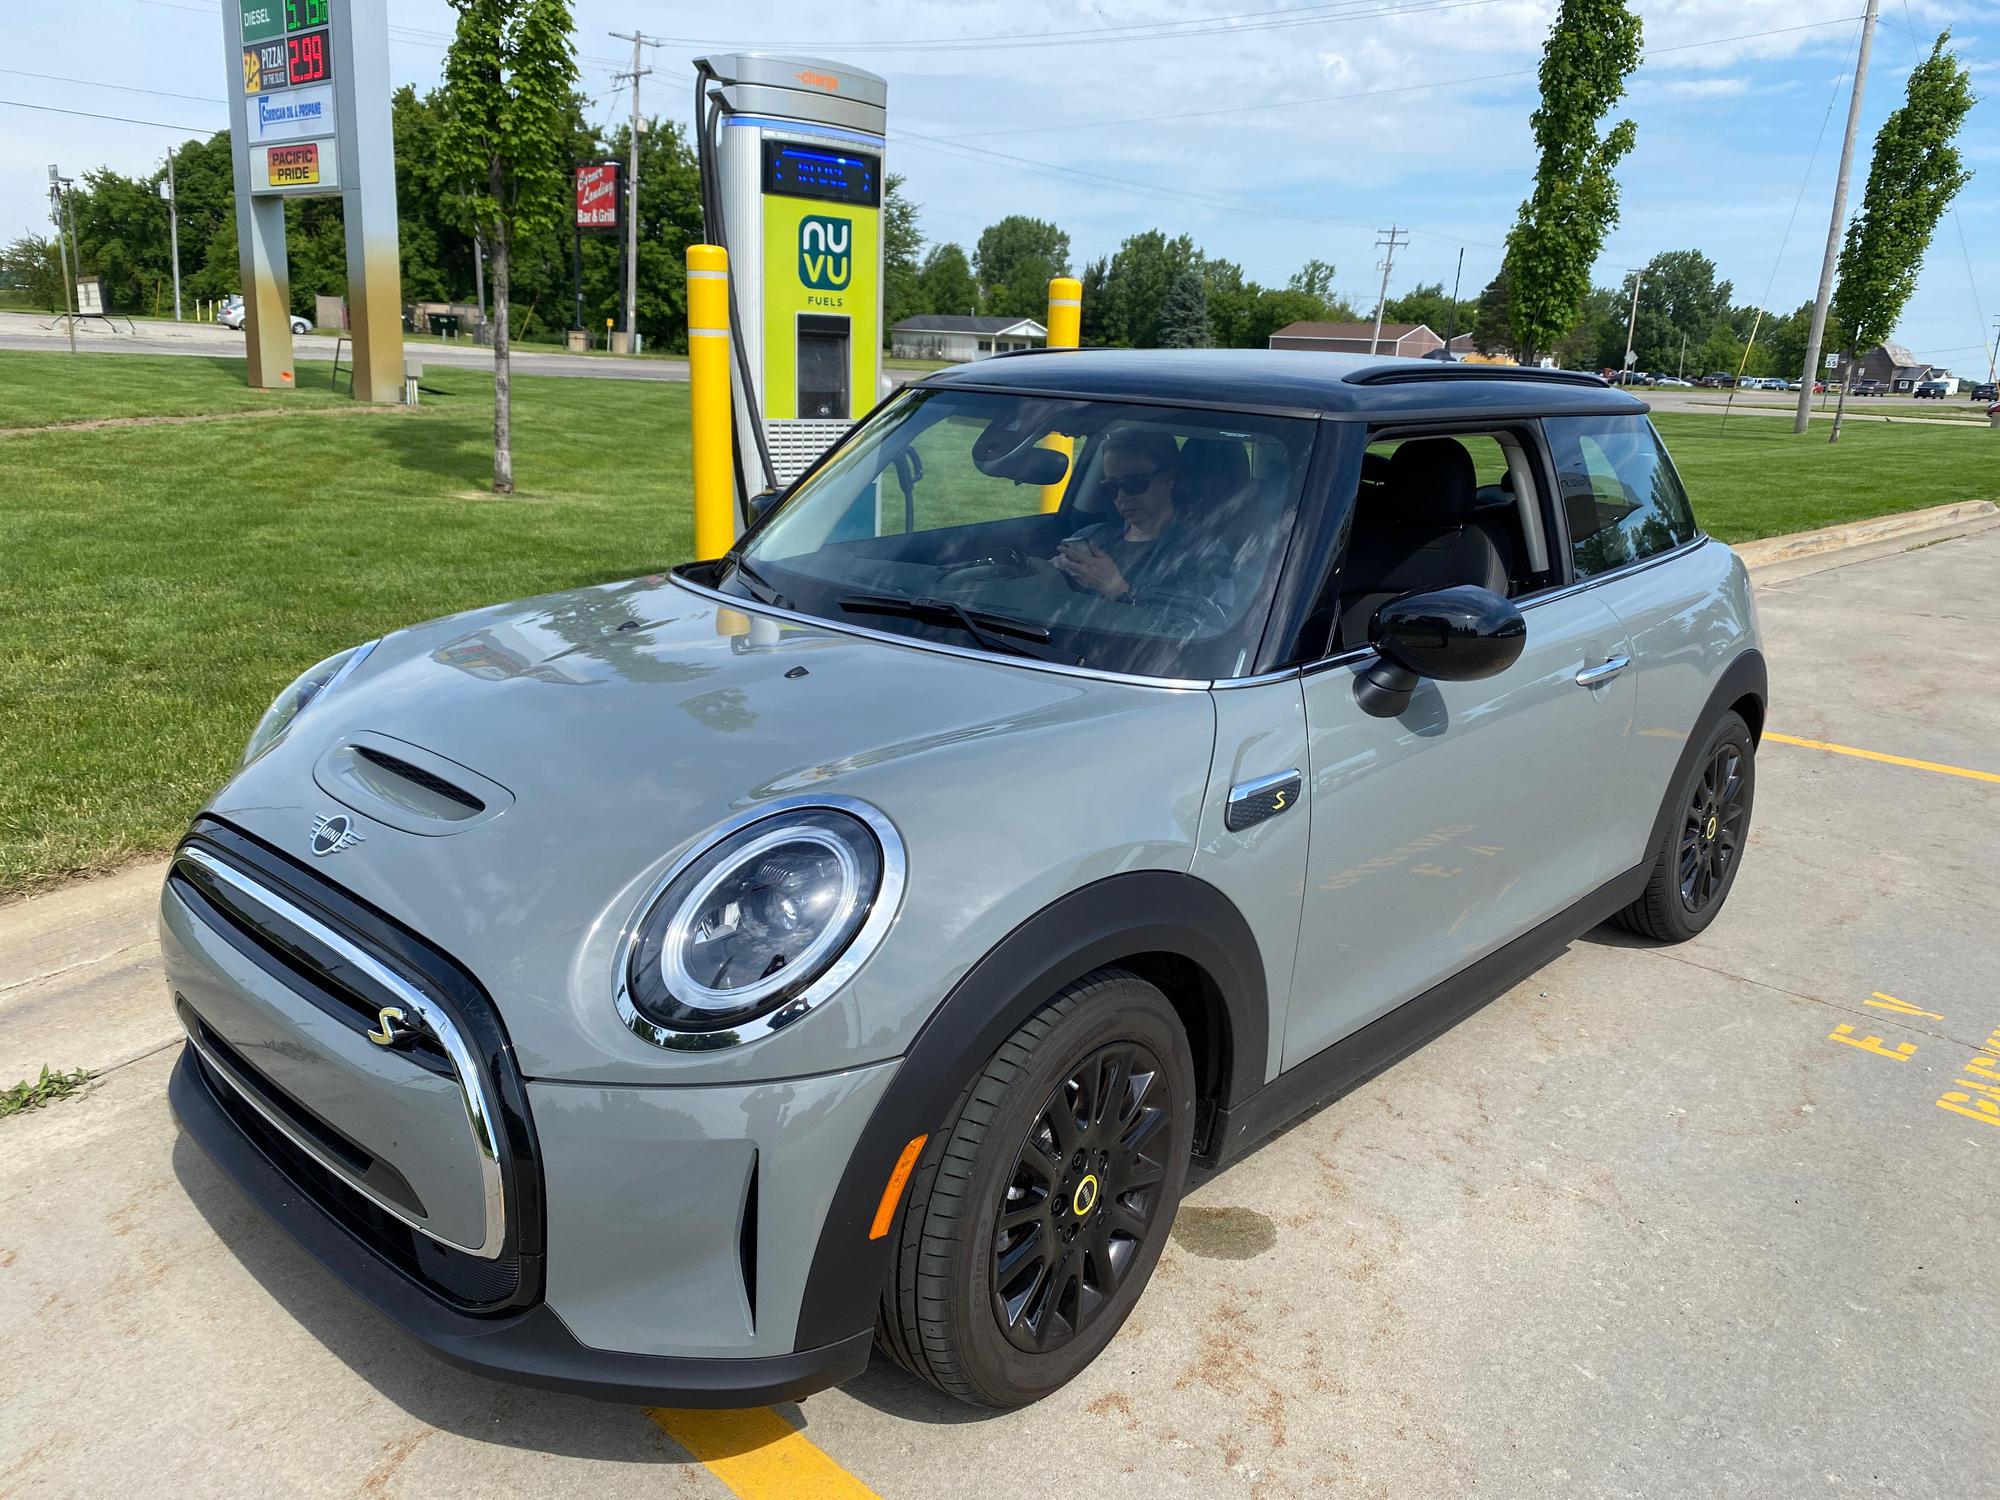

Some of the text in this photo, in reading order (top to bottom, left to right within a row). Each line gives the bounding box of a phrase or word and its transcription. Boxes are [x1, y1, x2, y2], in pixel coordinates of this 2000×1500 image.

[243, 8, 270, 27] DIESEL
[261, 45, 284, 69] PIZZA!
[288, 35, 323, 82] 2.99
[275, 72, 285, 83] SLICE
[286, 105, 294, 119] OIL
[299, 102, 321, 116] PROPANE
[272, 150, 313, 166] PACIFIC
[277, 166, 310, 180] PRIDE
[577, 208, 615, 223] Bar & Grill
[807, 296, 843, 307] FUELS
[1272, 790, 1286, 810] S
[320, 825, 341, 843] MINI
[367, 1006, 404, 1045] S
